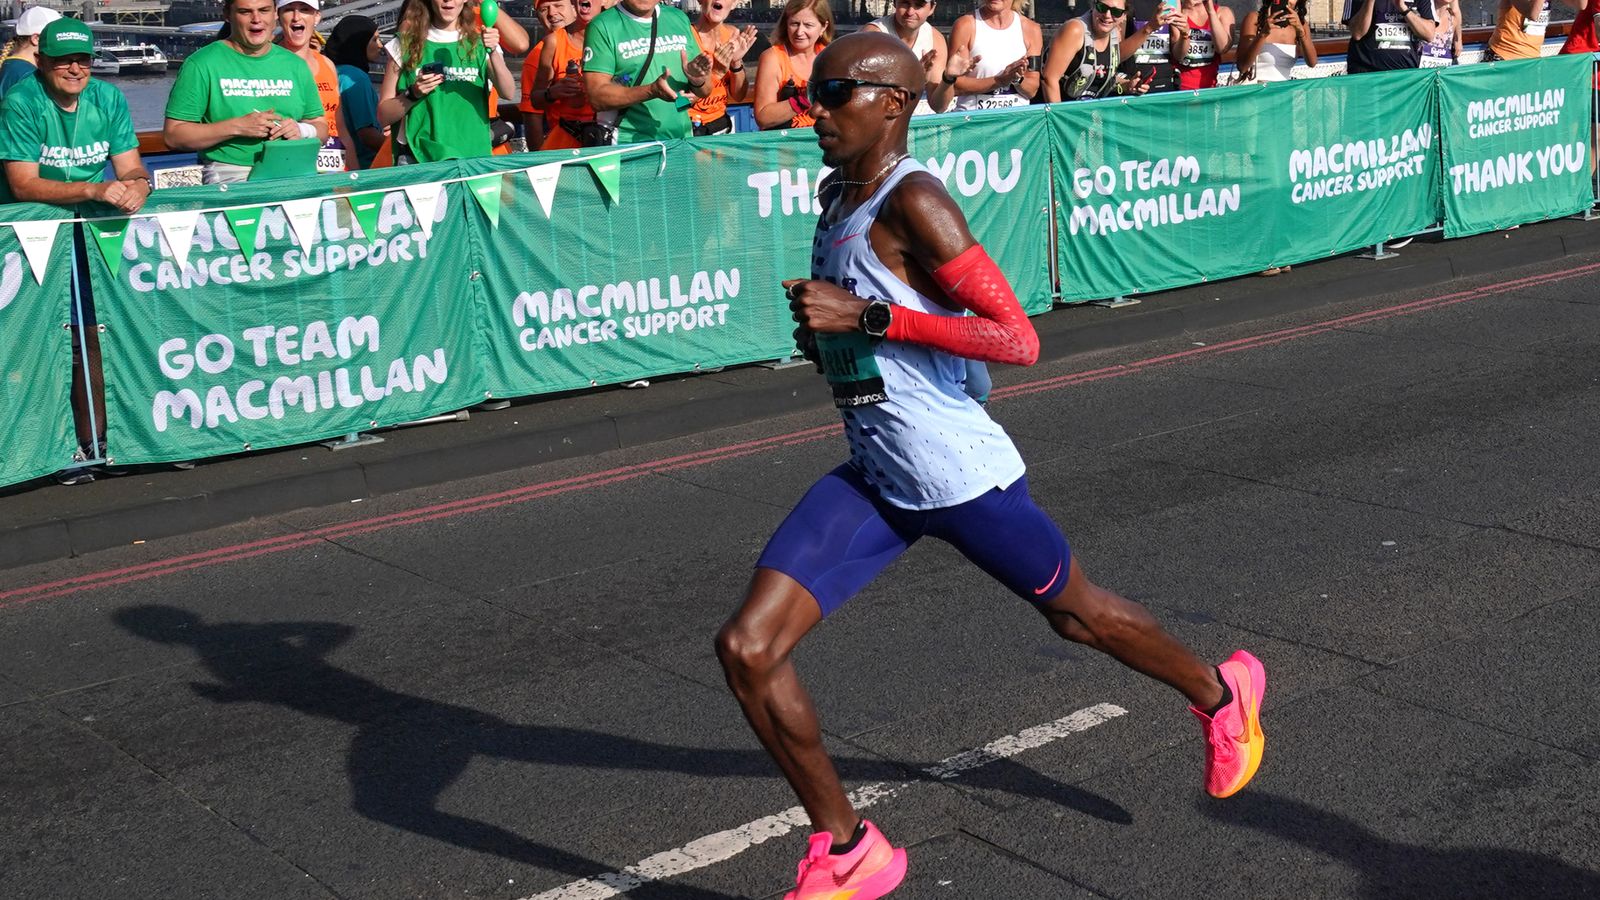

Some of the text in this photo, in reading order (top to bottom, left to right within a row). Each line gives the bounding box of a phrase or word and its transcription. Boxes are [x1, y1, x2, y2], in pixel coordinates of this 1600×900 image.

[220, 78, 293, 89] MACMILLAN
[222, 88, 291, 98] CANCER SUPPORT
[1467, 88, 1565, 124] MACMILLAN
[1469, 110, 1560, 139] CANCER SUPPORT
[926, 149, 1023, 197] YOU
[1073, 155, 1200, 199] GO TEAM
[1289, 122, 1432, 183] MACMILLAN
[1449, 141, 1585, 195] THANK YOU
[1291, 154, 1425, 204] CANCER SUPPORT
[1070, 184, 1241, 236] MACMILLAN
[129, 231, 432, 292] CANCER SUPPORT
[512, 268, 740, 328] MACMILLAN
[158, 315, 380, 380] GO TEAM
[519, 303, 730, 352] CANCER SUPPORT
[152, 348, 449, 432] MACMILLAN
